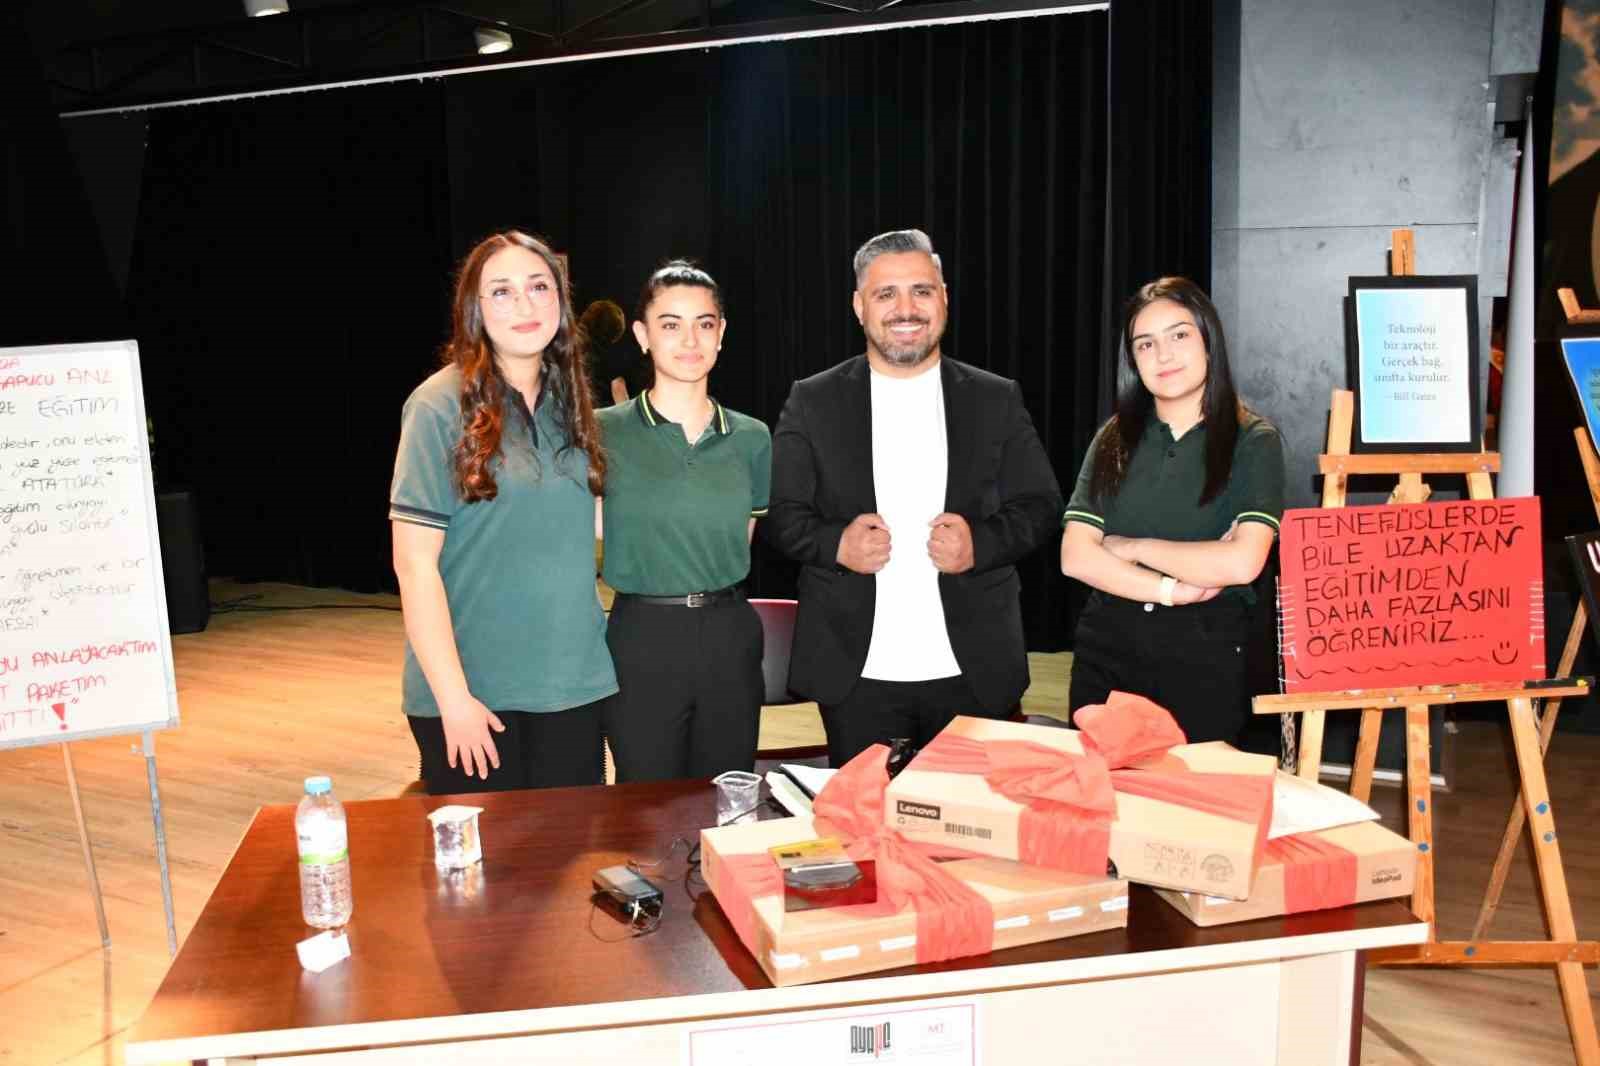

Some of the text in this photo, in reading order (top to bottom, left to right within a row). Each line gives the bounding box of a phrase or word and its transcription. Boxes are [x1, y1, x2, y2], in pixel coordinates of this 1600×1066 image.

[1302, 526, 1524, 571] BİLE UZAKTAN
[1305, 560, 1470, 602] EĞİTİMDEN
[1306, 587, 1511, 628] DAHA FAZLASINI
[898, 802, 938, 818] Lenovo
